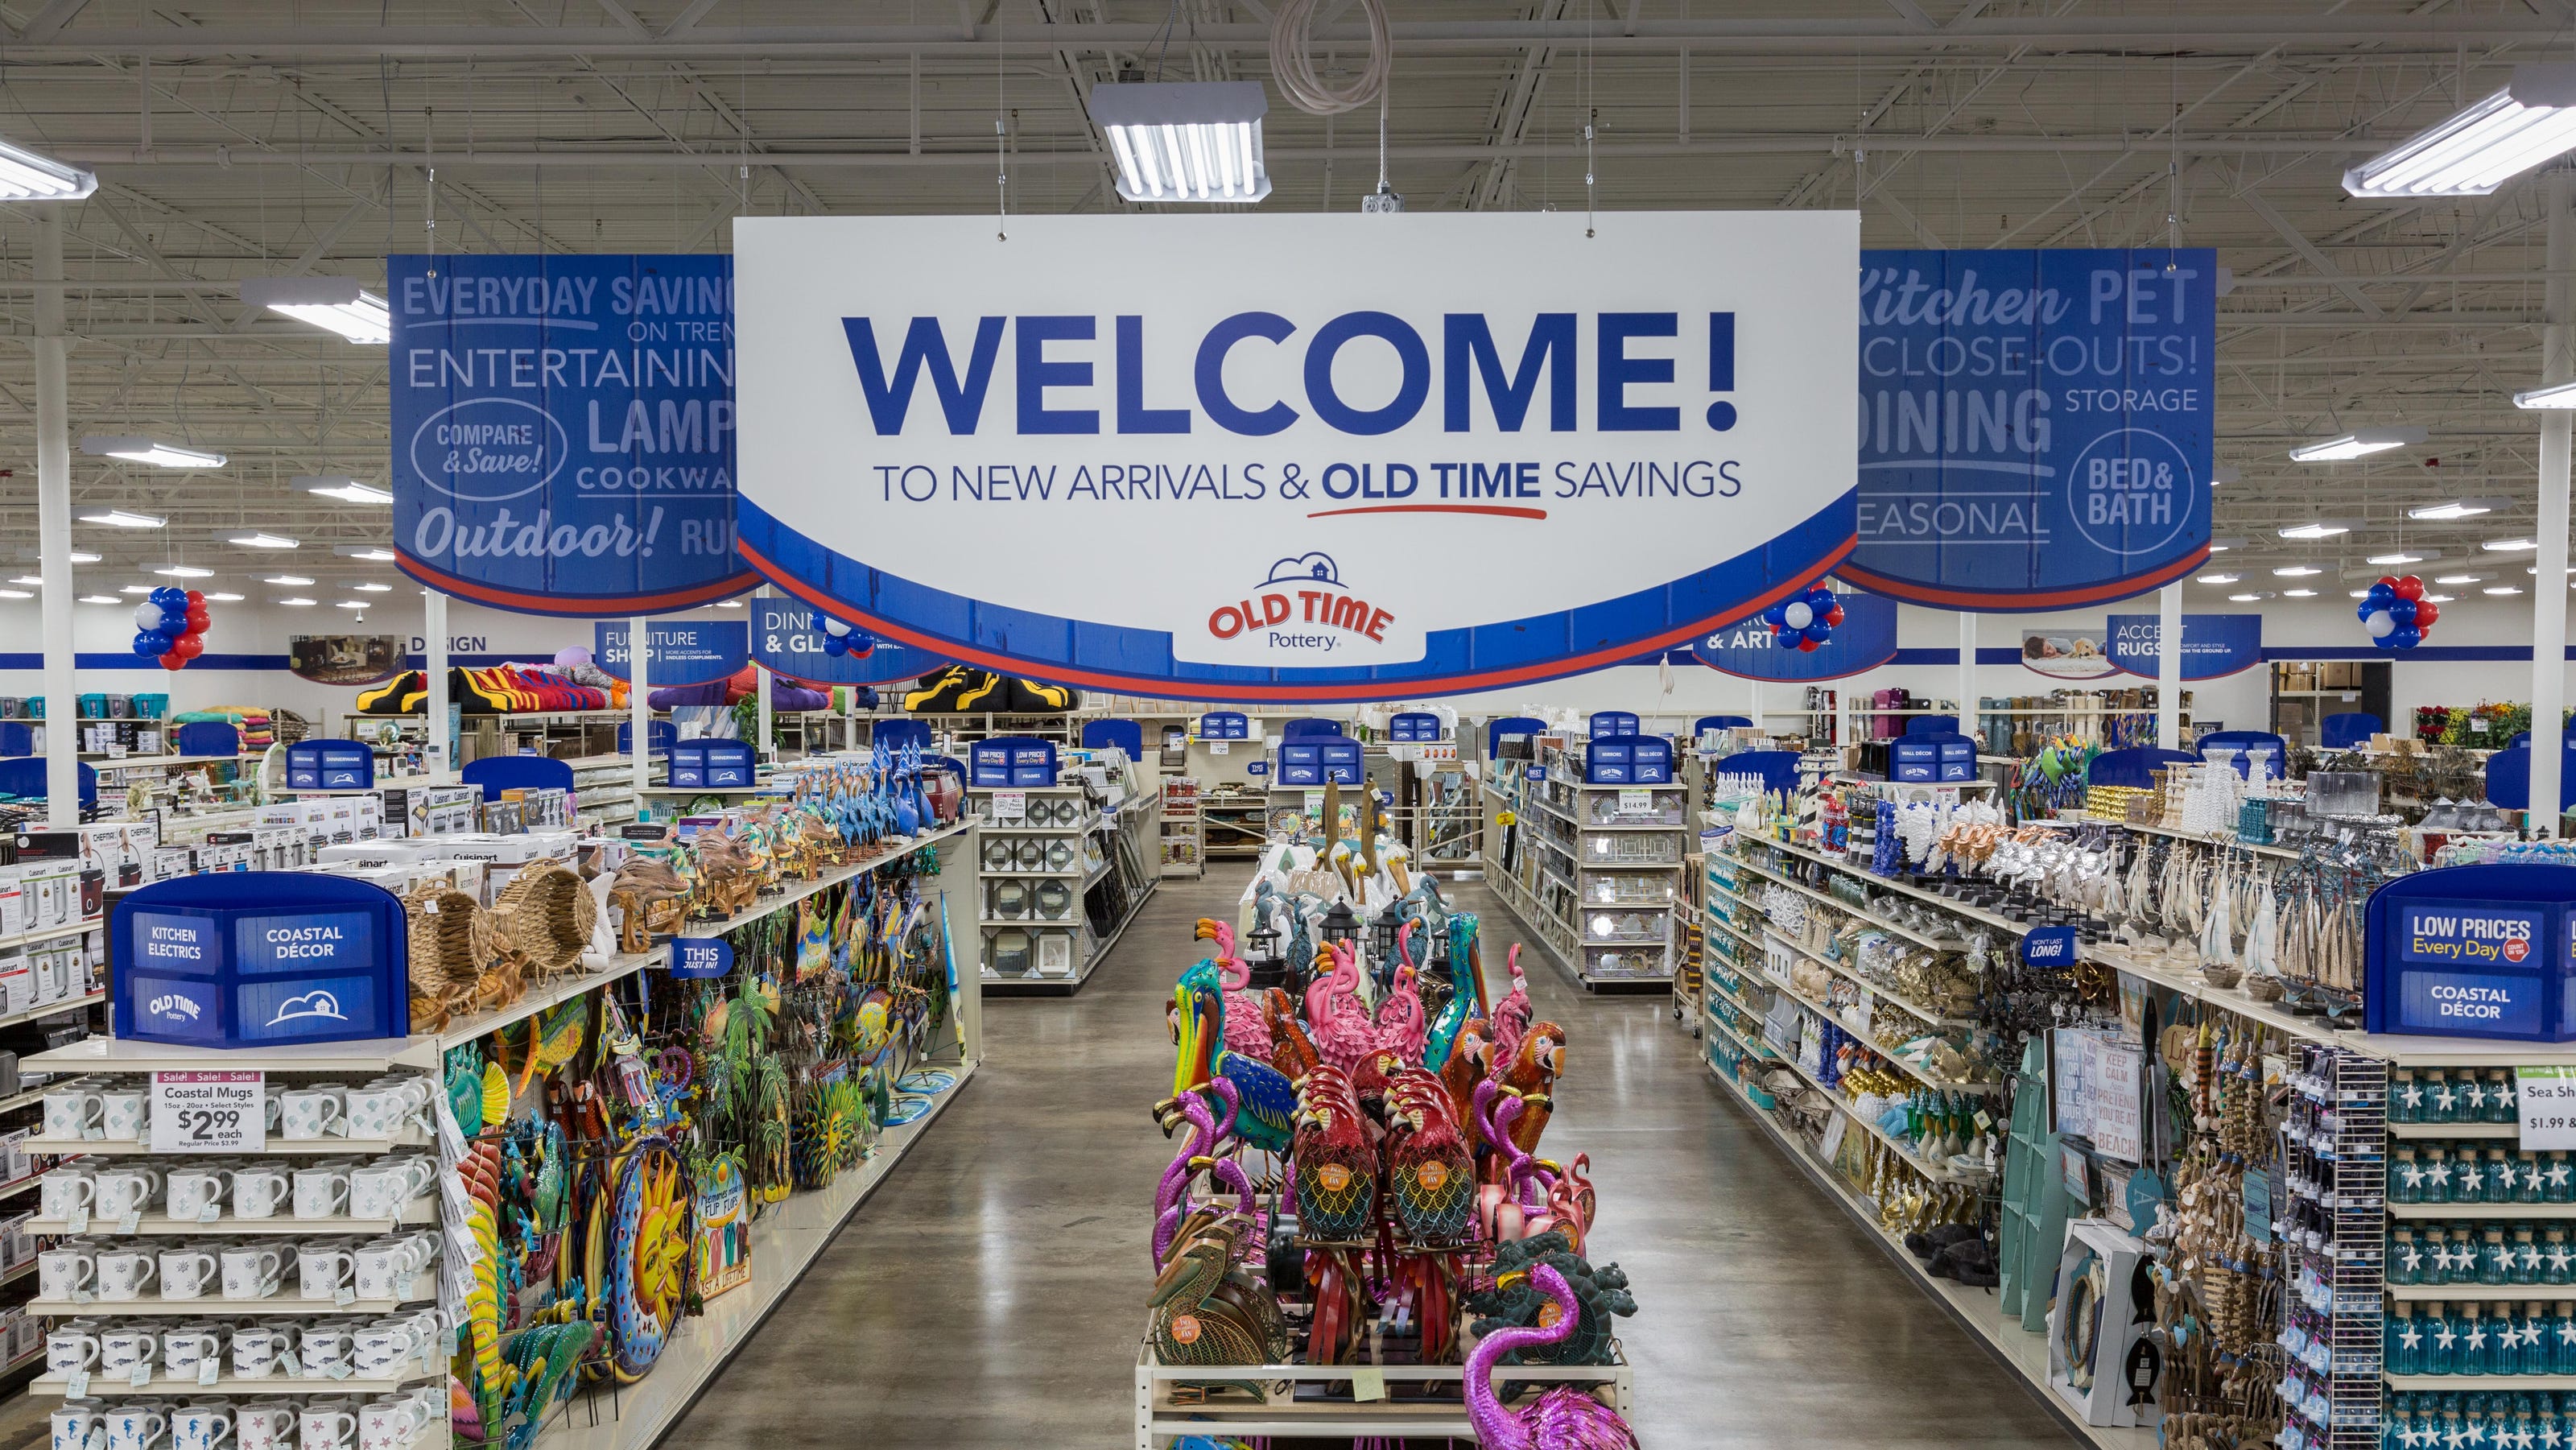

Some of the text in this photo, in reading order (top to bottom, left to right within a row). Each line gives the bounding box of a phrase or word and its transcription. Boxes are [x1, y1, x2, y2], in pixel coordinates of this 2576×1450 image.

[403, 276, 598, 316] EVERYDAY
[2090, 269, 2198, 325] PET
[628, 321, 667, 342] ON
[1864, 335, 2198, 377] CLOSE-OUTS!
[410, 349, 734, 388] ENTERTAININ
[840, 310, 1738, 436] WELCOME!
[2065, 389, 2198, 412] STORAGE
[436, 424, 533, 445] COMPARE
[588, 399, 736, 454] LAMP
[576, 467, 733, 490] COOKWA
[873, 460, 1742, 502] TO NEW ARRIVALS & OLD TIME SAVINGS
[2088, 493, 2171, 525] BATH
[415, 506, 664, 559] Outdoor!
[1208, 590, 1396, 645] OLD TIME
[606, 631, 698, 647] FUITURE
[2117, 625, 2188, 639] ACCET
[412, 636, 487, 652] DIGN
[766, 634, 782, 653] &
[1269, 632, 1336, 651] Pottery
[1707, 633, 1724, 649] &
[2117, 642, 2162, 656] RUGS
[605, 648, 654, 663] SHP
[1028, 750, 1046, 758] PRICES
[434, 793, 451, 803] Cuisinart
[454, 791, 470, 800] Cuisinart
[525, 850, 539, 859] Cuisinart
[550, 848, 566, 858] Cuisinart
[29, 869, 47, 877] Cuisinart
[58, 865, 74, 874] Cuisinart
[151, 927, 196, 943] KITCHEN
[266, 927, 343, 943] COASTAL
[2413, 916, 2531, 940] LOW PRICES
[27, 944, 45, 952] Cuisinart
[59, 939, 76, 947] Cuisinart
[148, 942, 201, 960] ELECTRICS
[2030, 944, 2062, 958] LONG!
[2413, 938, 2500, 960] Every Day
[276, 944, 335, 959] DÉCOR
[683, 948, 719, 961] THIS
[683, 961, 718, 969] JUST IN!
[2431, 985, 2511, 1003] COASTAL
[150, 994, 200, 1021] OLD TIME
[2441, 1001, 2500, 1019] DÉCOR
[167, 1012, 186, 1023] Pottery
[2057, 1047, 2079, 1061] HIGH
[2106, 1052, 2127, 1068] KEEP
[163, 1072, 254, 1082] Sale! Sale! Sale!
[2059, 1076, 2079, 1090] LOW
[2105, 1067, 2128, 1083] CALM
[165, 1087, 254, 1101] Coastal Mugs
[2098, 1088, 2136, 1109] PRETEND
[2528, 1085, 2576, 1098] Sea Sh
[2058, 1104, 2081, 1119] YOUR
[2098, 1105, 2136, 1127] YOU'RE AT
[2530, 1117, 2565, 1130] $1.99
[217, 1129, 242, 1138] each
[179, 1140, 202, 1148] Regular
[2098, 1132, 2136, 1157] BEACH
[724, 1196, 738, 1214] FLOPS
[714, 1278, 720, 1290] A
[722, 1266, 746, 1288] LIFETIME
